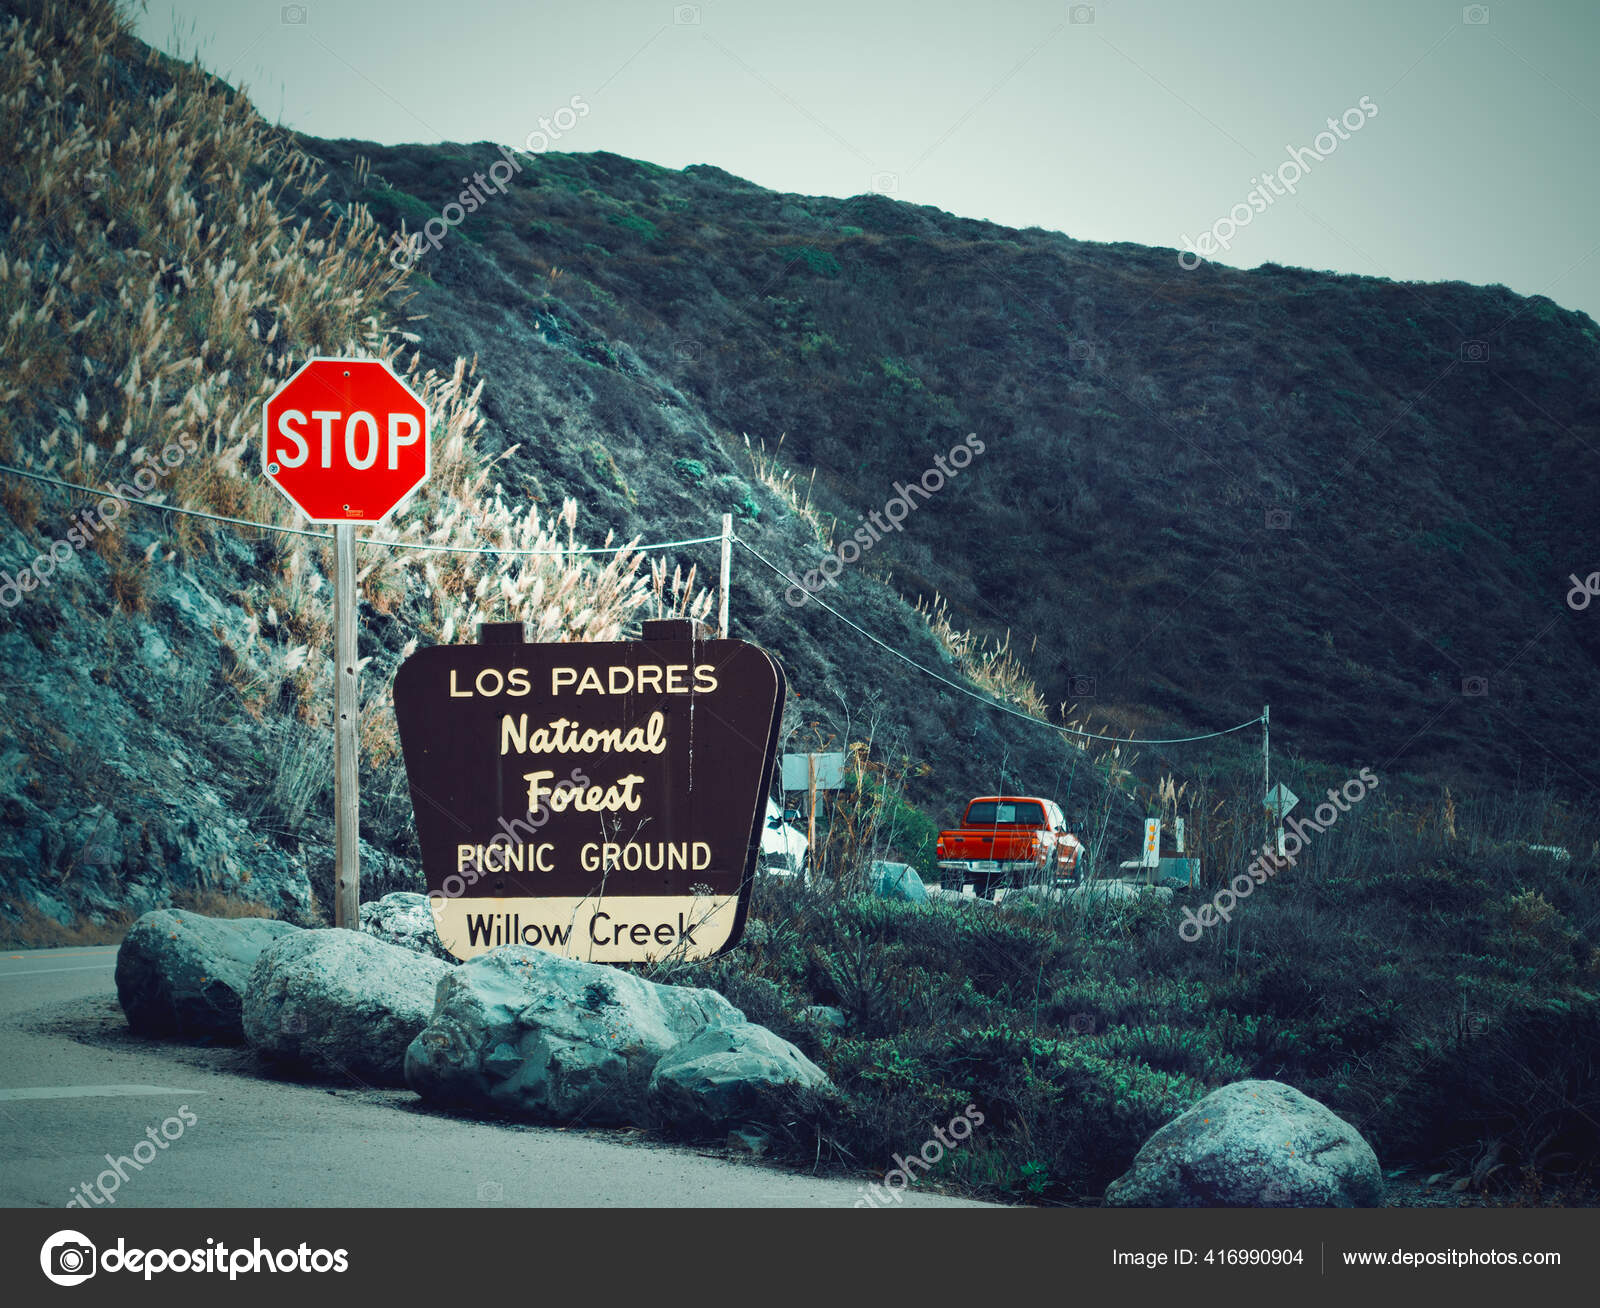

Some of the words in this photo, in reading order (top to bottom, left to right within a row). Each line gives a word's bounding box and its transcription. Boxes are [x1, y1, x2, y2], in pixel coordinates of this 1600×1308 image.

[276, 409, 421, 471] STOP
[450, 668, 531, 698] LOS
[552, 664, 719, 696] PADRES
[500, 711, 667, 756] National
[523, 769, 645, 814] Forest
[457, 843, 555, 873] PICNIC
[580, 841, 712, 872] GROUND
[466, 912, 573, 947] Willow
[589, 912, 698, 946] Creek
